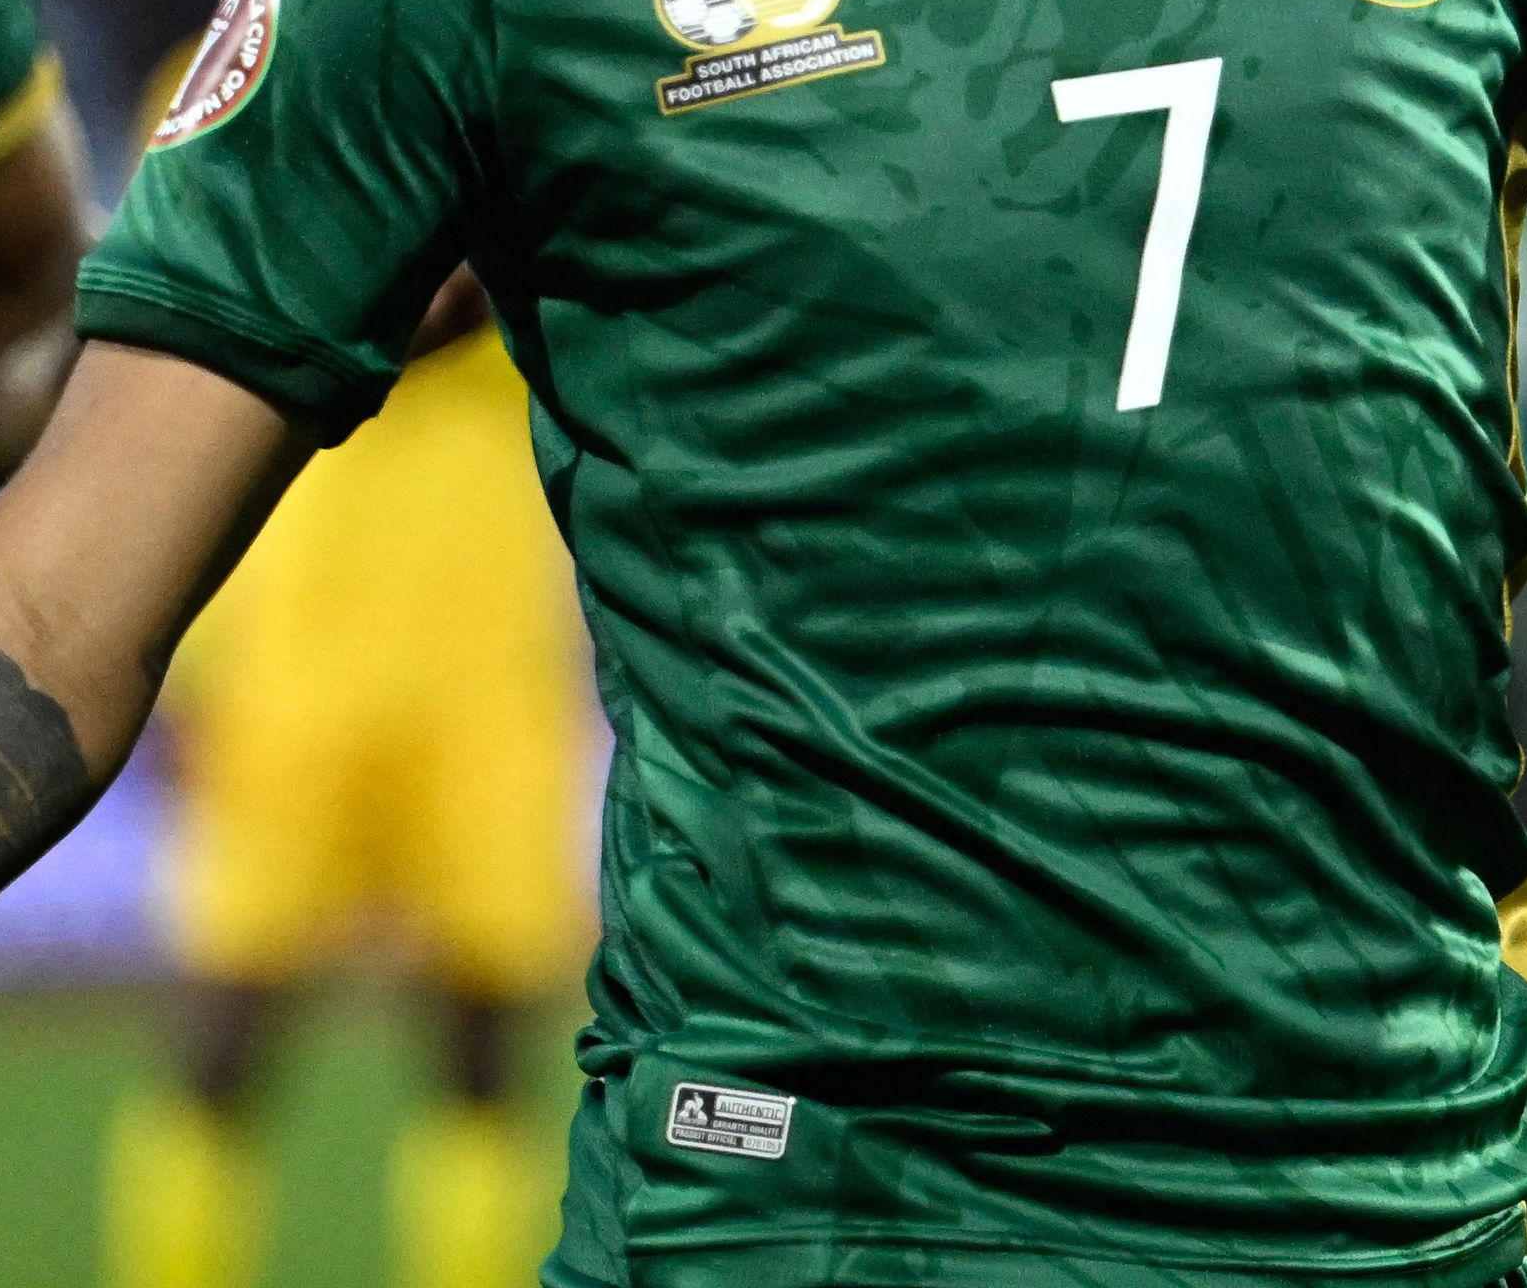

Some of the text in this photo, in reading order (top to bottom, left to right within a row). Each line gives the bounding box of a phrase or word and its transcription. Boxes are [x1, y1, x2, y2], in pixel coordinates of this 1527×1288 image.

[240, 22, 265, 69] CUP
[695, 34, 837, 79] SOUTH AFRICAN
[220, 69, 246, 102] OF
[667, 44, 875, 105] FOOTBALL ASSOCIATION
[1050, 57, 1223, 411] 7
[719, 1100, 784, 1122] AUTHENTIC
